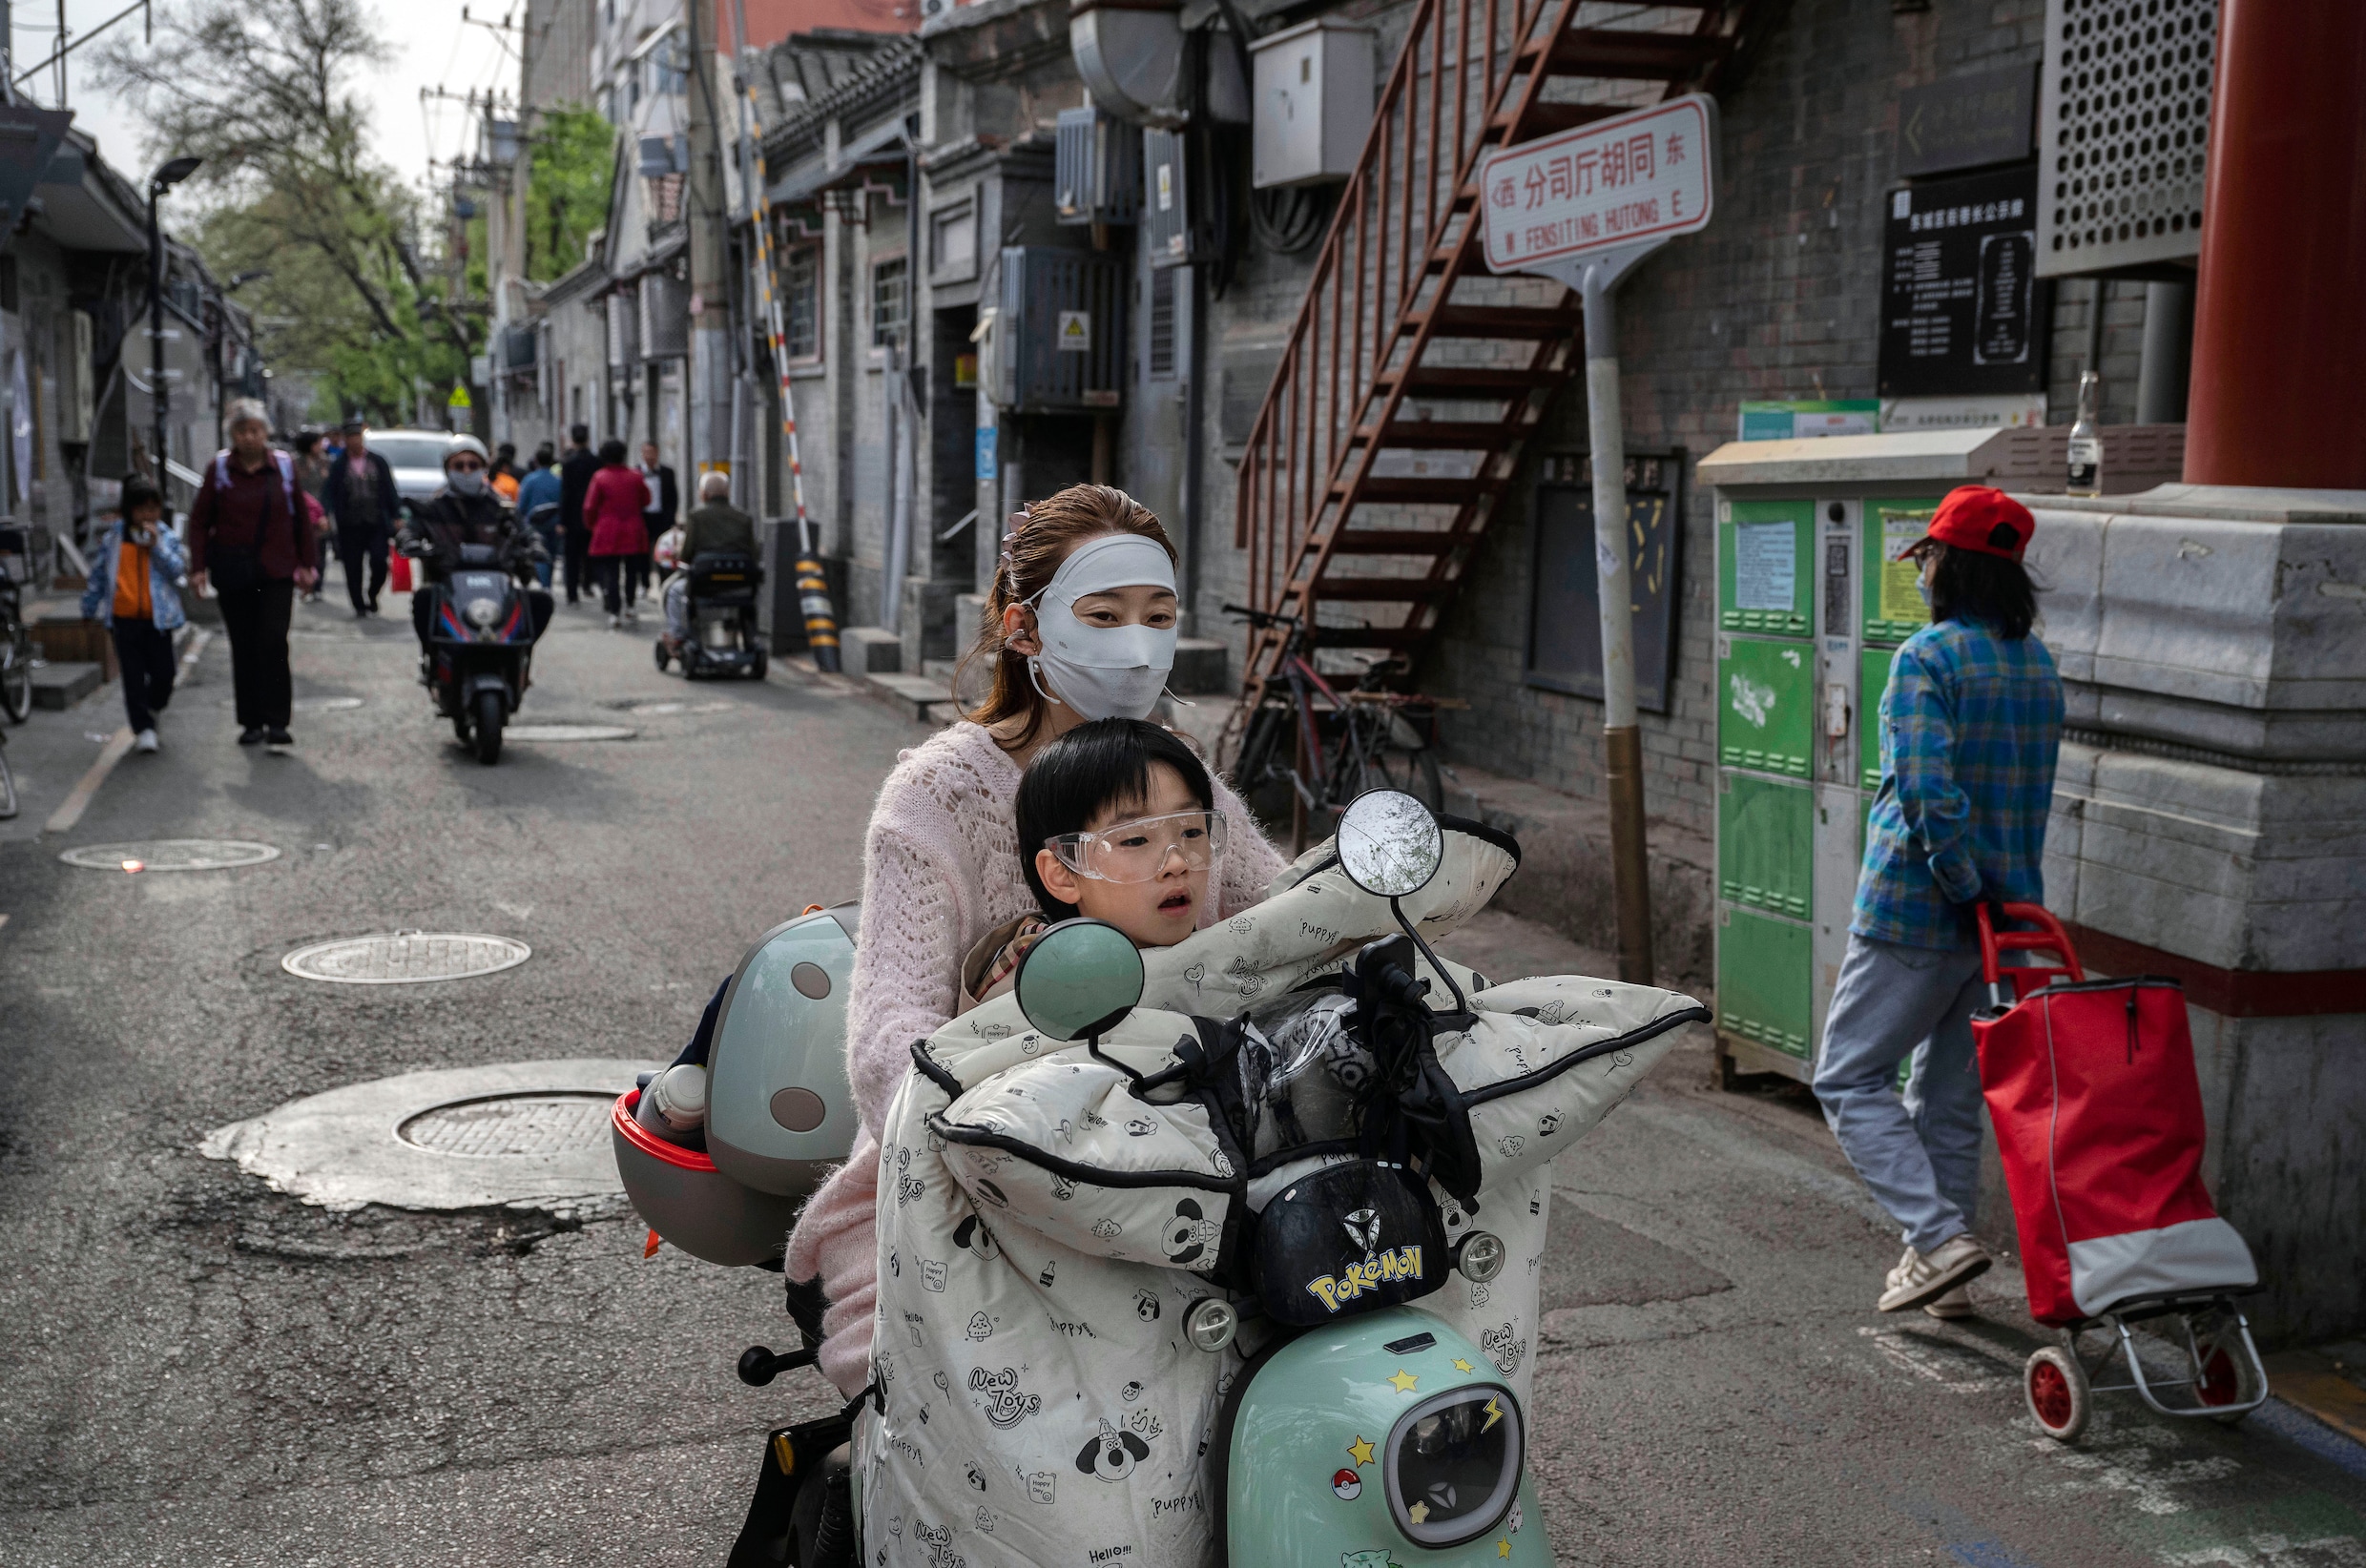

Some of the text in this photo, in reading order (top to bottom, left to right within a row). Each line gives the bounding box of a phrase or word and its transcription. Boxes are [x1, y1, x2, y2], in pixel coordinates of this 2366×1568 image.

[1500, 132, 1685, 211] 西 分司厅胡同 东
[1526, 213, 1599, 252] FENSITING
[1605, 197, 1660, 233] HUTONG
[1671, 190, 1683, 217] E
[1302, 920, 1336, 944] puppy
[925, 1267, 944, 1275] Happy
[1484, 1323, 1512, 1348] New
[969, 1368, 1016, 1389] New
[986, 1390, 1039, 1423] Toys
[1032, 1479, 1050, 1488] Happy
[1032, 1487, 1044, 1496] Day
[1154, 1495, 1193, 1516] puppy
[916, 1520, 950, 1541] New
